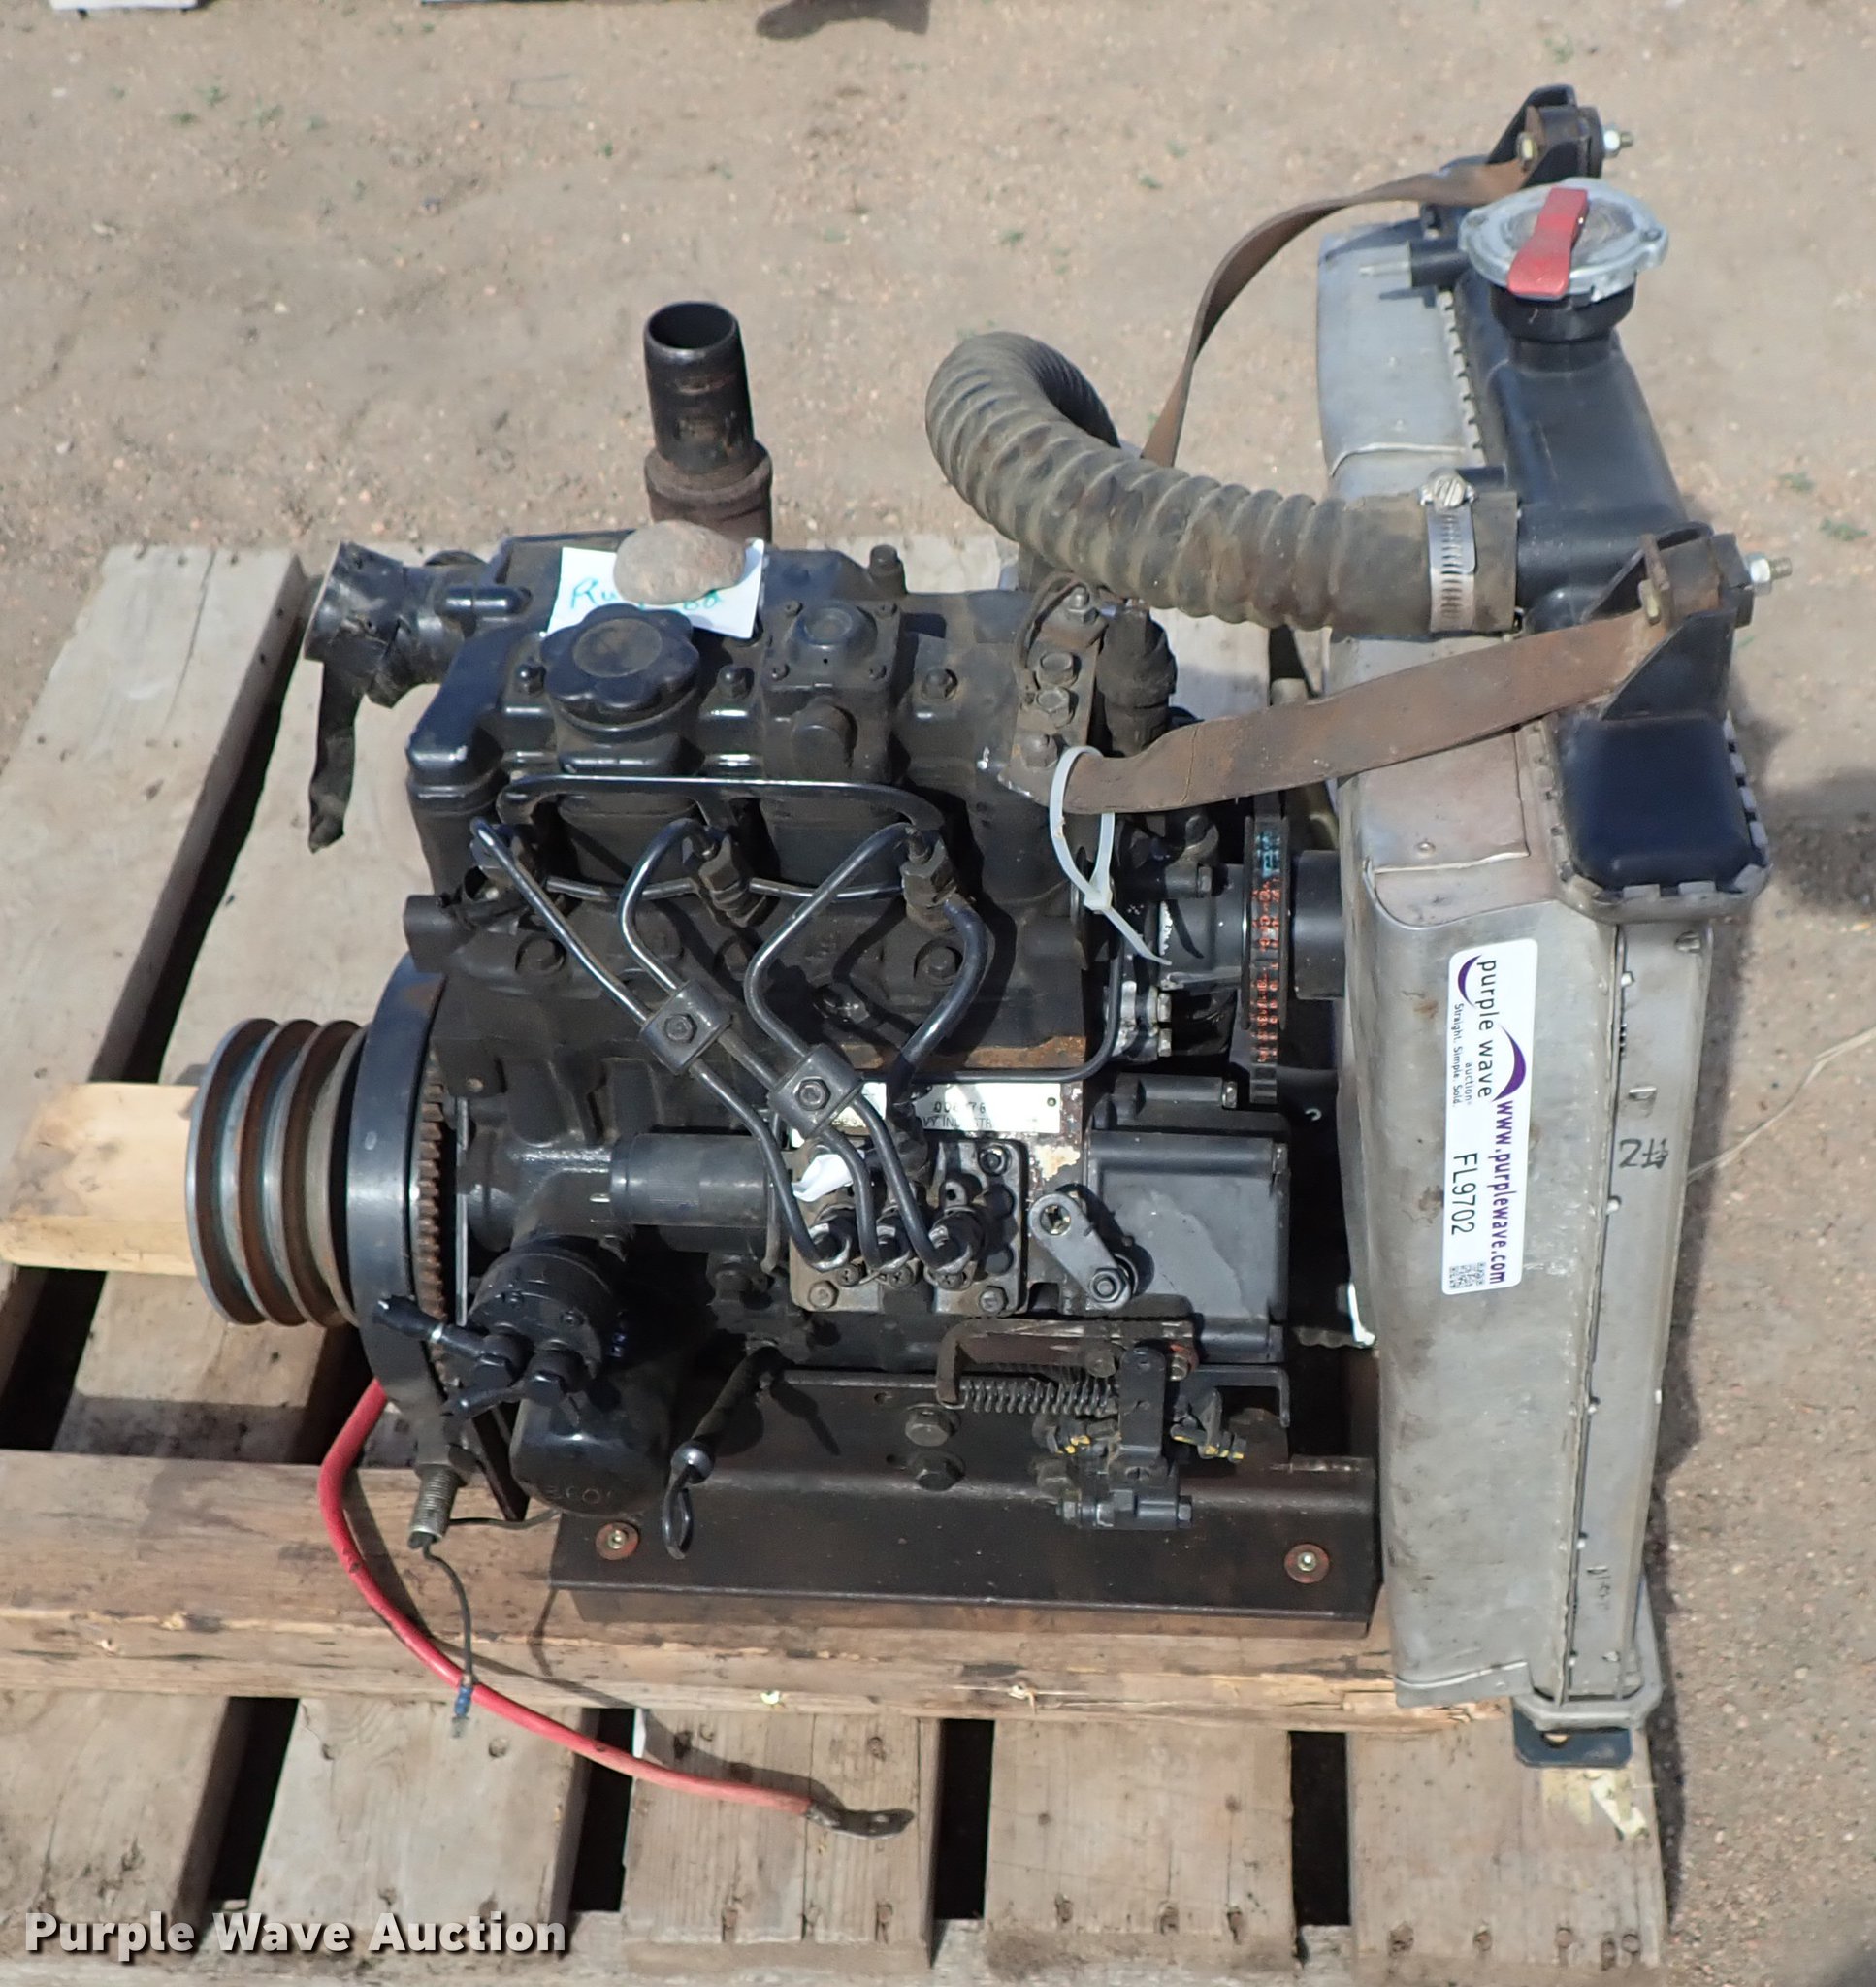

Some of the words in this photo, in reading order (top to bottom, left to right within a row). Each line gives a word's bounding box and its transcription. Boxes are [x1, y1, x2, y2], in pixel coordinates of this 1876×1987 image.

[1474, 959, 1500, 1030] purple
[1465, 1061, 1475, 1101] auction
[1477, 1039, 1495, 1099] wave
[1451, 1152, 1478, 1236] FL9702
[1486, 1099, 1517, 1285] www.purplewave.com
